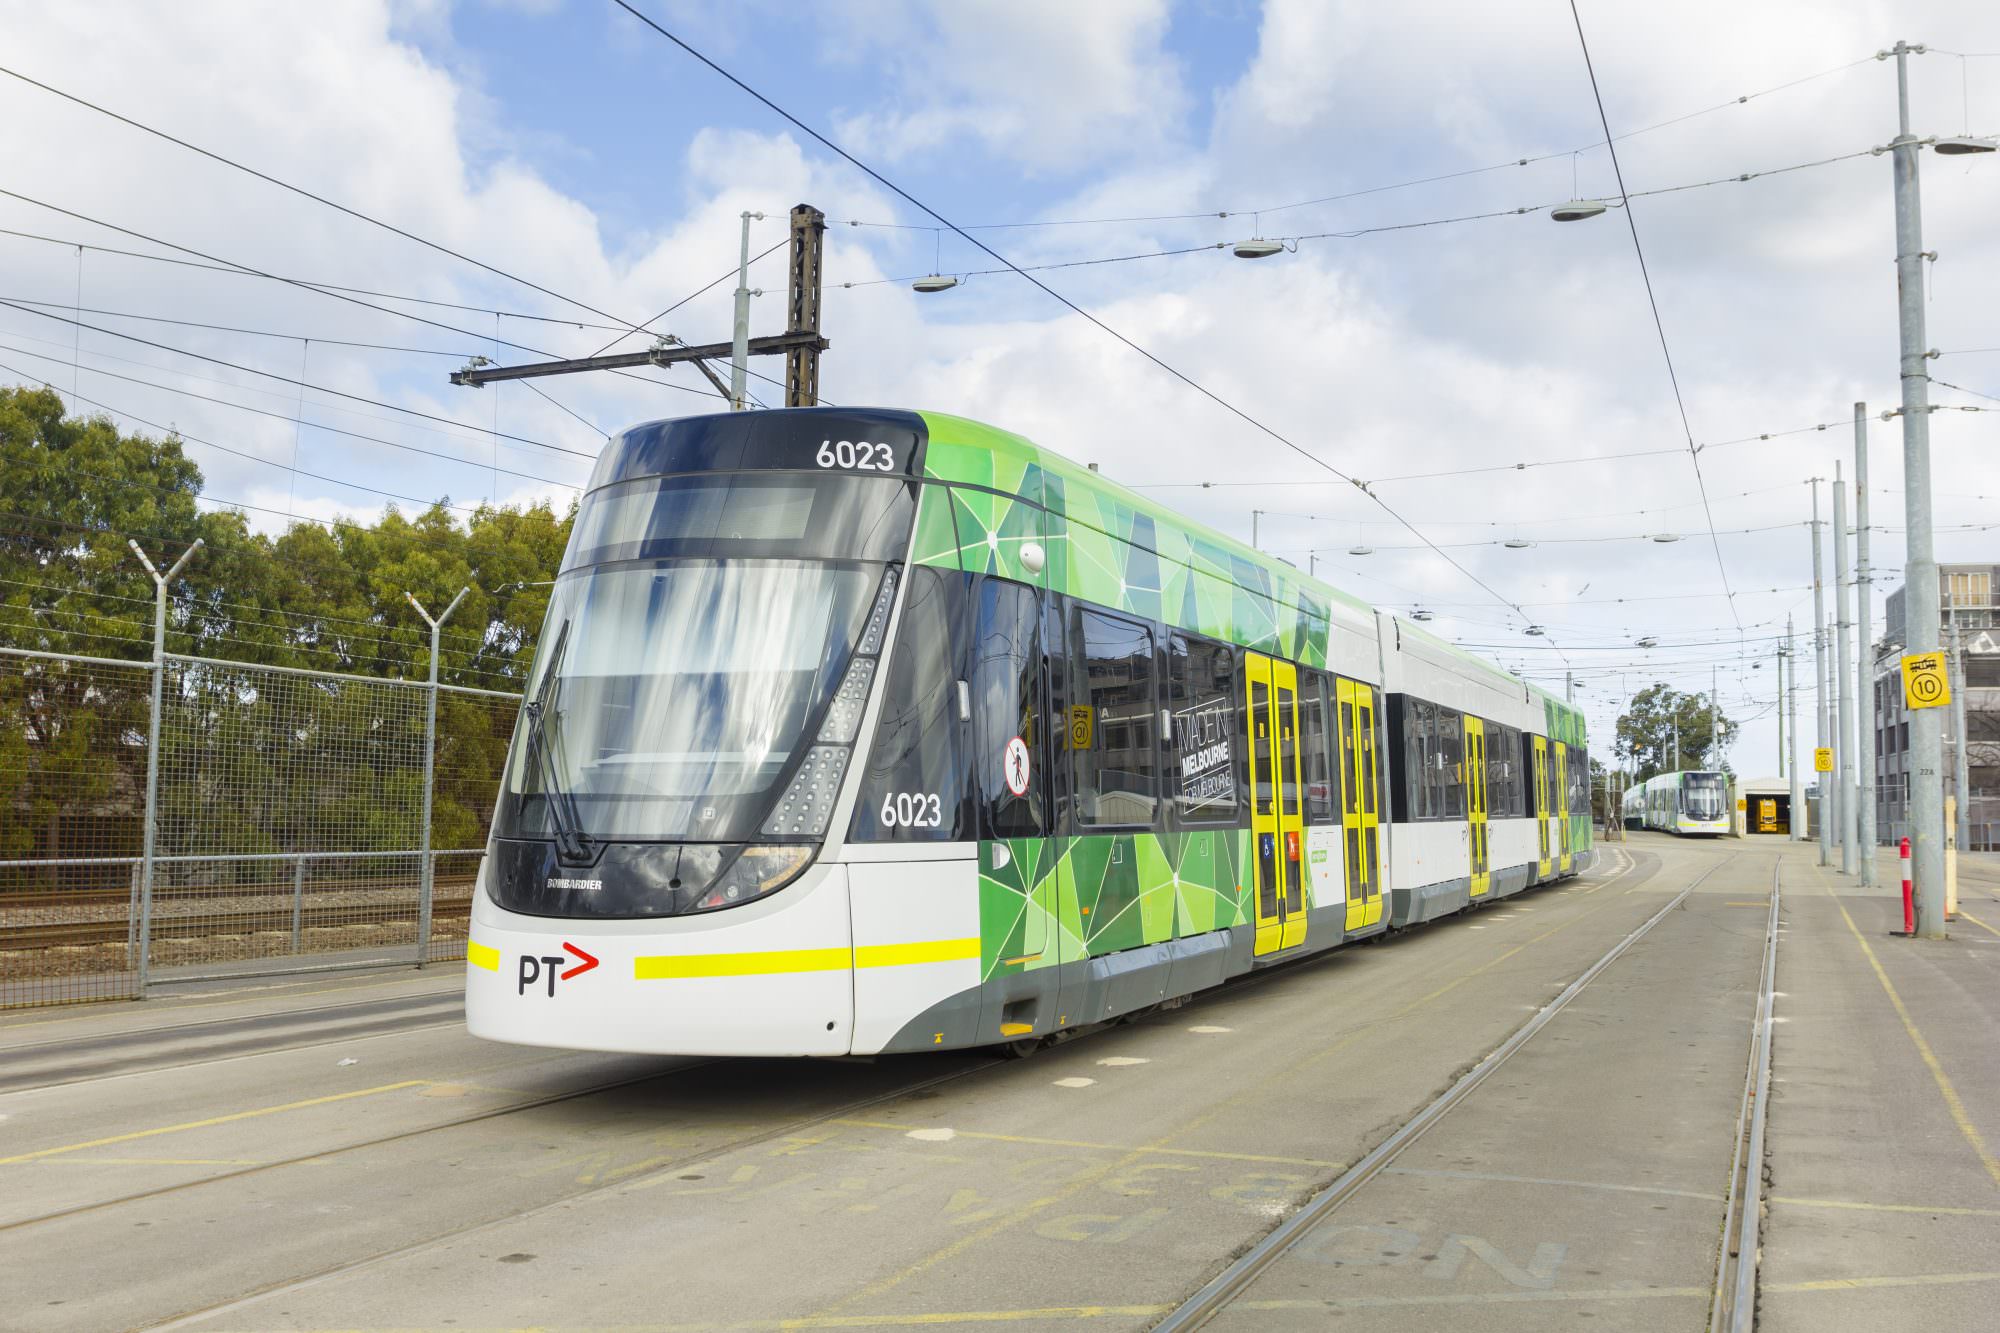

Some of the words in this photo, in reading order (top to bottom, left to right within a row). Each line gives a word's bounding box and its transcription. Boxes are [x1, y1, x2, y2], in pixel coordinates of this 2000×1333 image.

[816, 440, 894, 471] 6023
[1918, 679, 1936, 695] 10
[1178, 708, 1216, 753] MADE
[1182, 740, 1229, 777] MELBOURNE
[1197, 770, 1231, 800] MELBOURNE
[881, 792, 941, 827] 6023
[547, 878, 603, 891] BOMBARDIER
